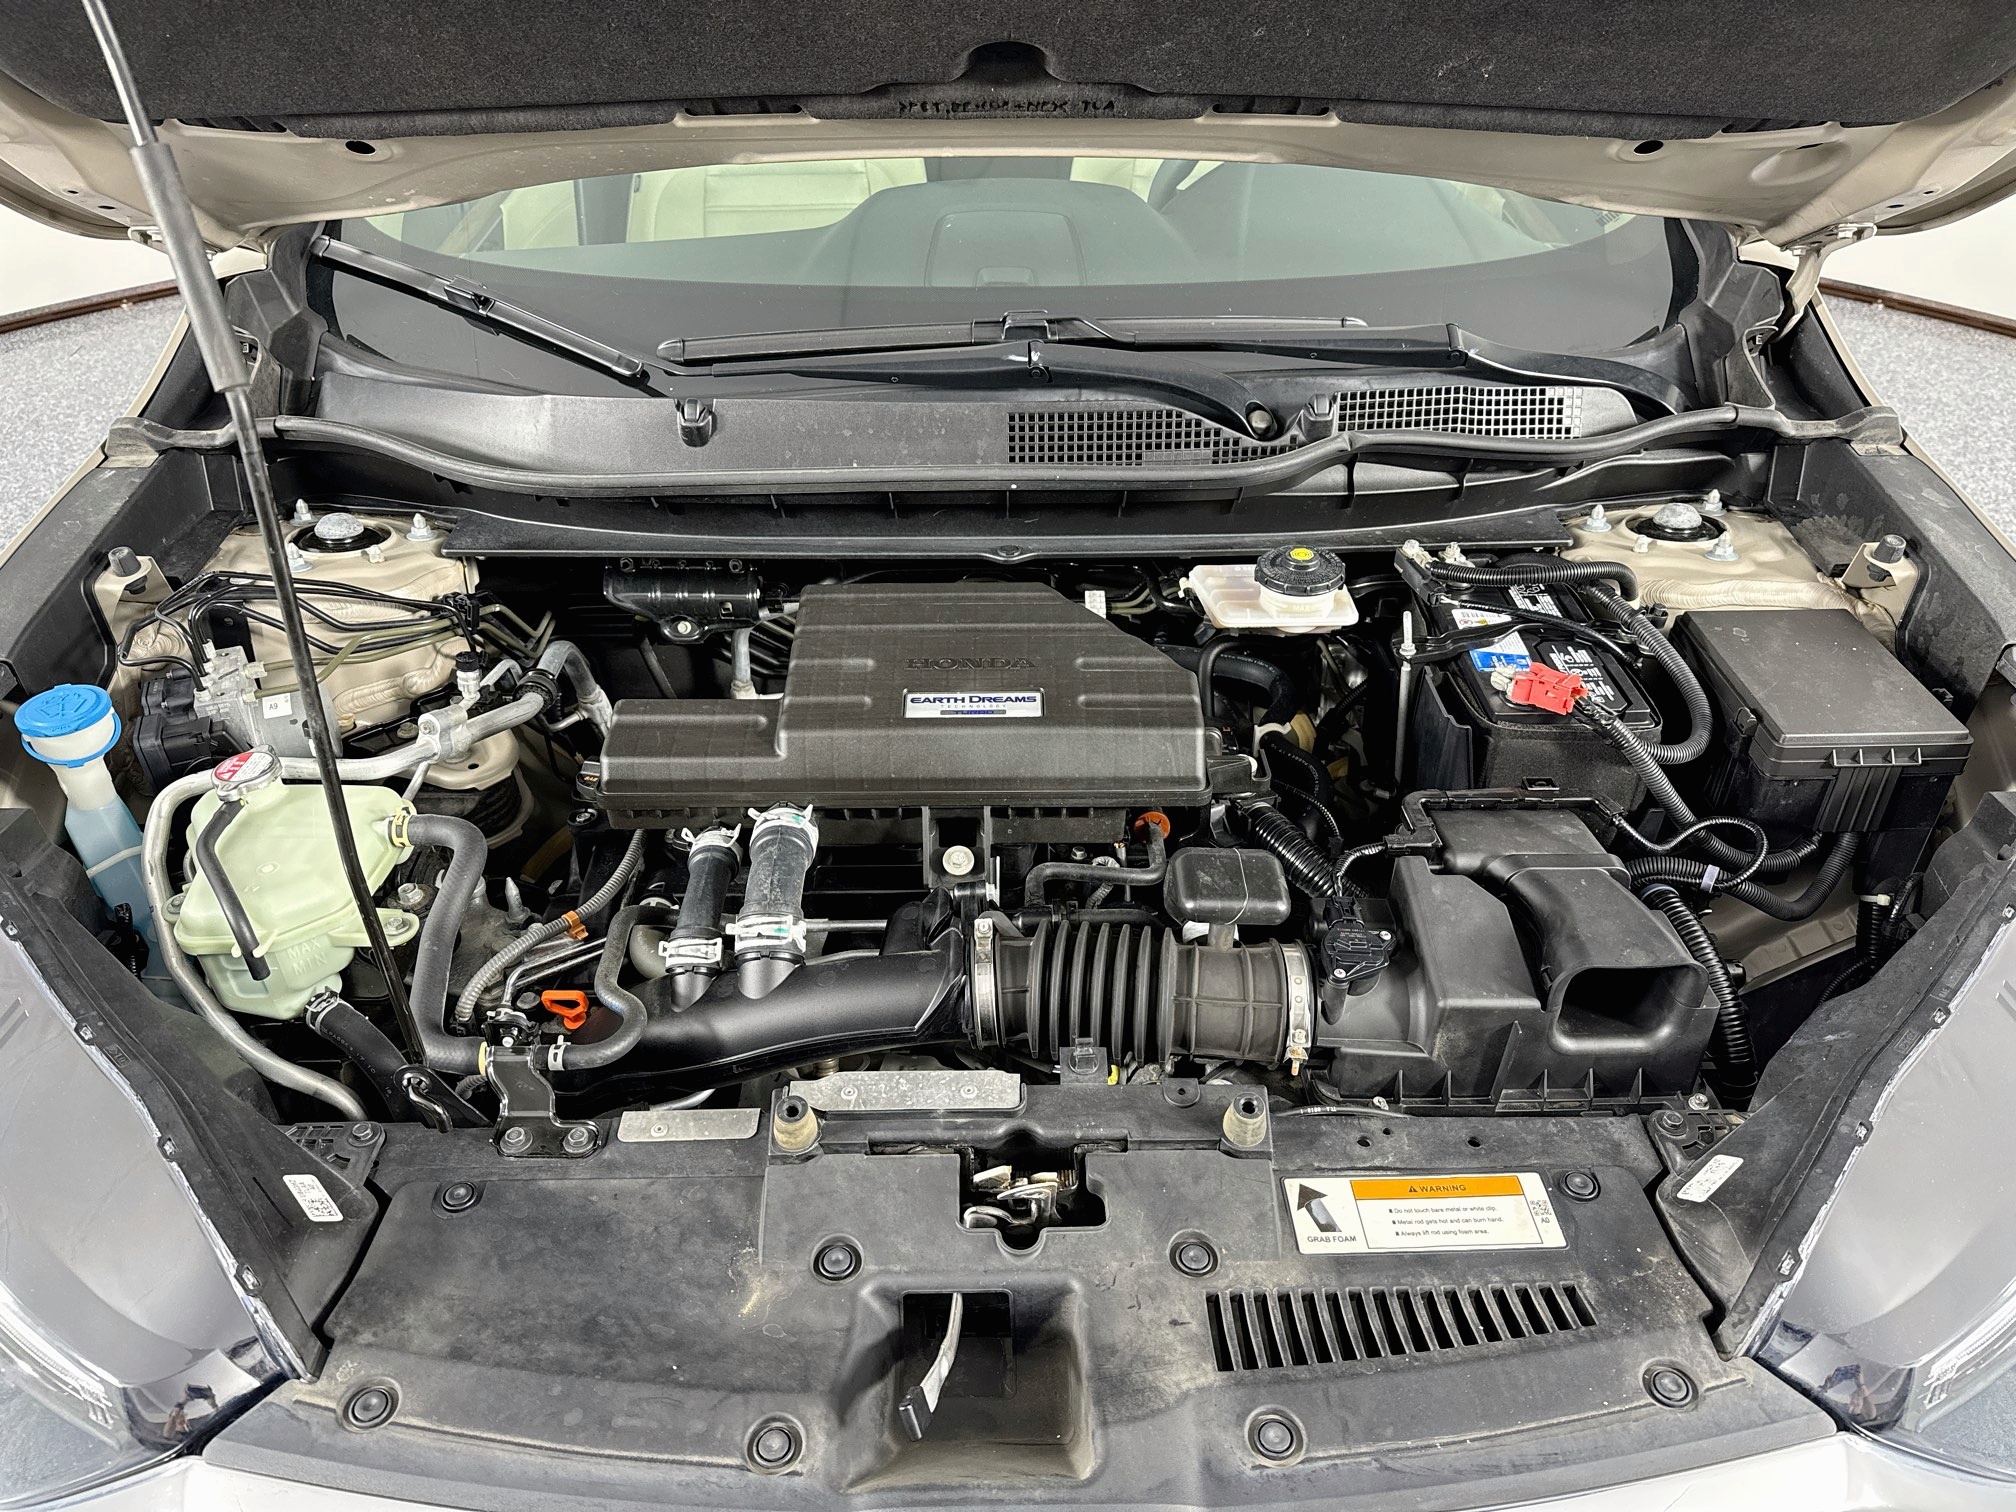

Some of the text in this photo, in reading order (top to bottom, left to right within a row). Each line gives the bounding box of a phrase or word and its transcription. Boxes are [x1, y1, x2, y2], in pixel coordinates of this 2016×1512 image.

[904, 657, 1038, 671] HONDA
[969, 695, 1037, 703] DREAMS
[268, 703, 279, 711] A9
[287, 939, 322, 960] MAX
[291, 952, 327, 976] MIN
[1419, 1184, 1467, 1193] WARNING
[1307, 1235, 1357, 1243] GRAB FOAM
